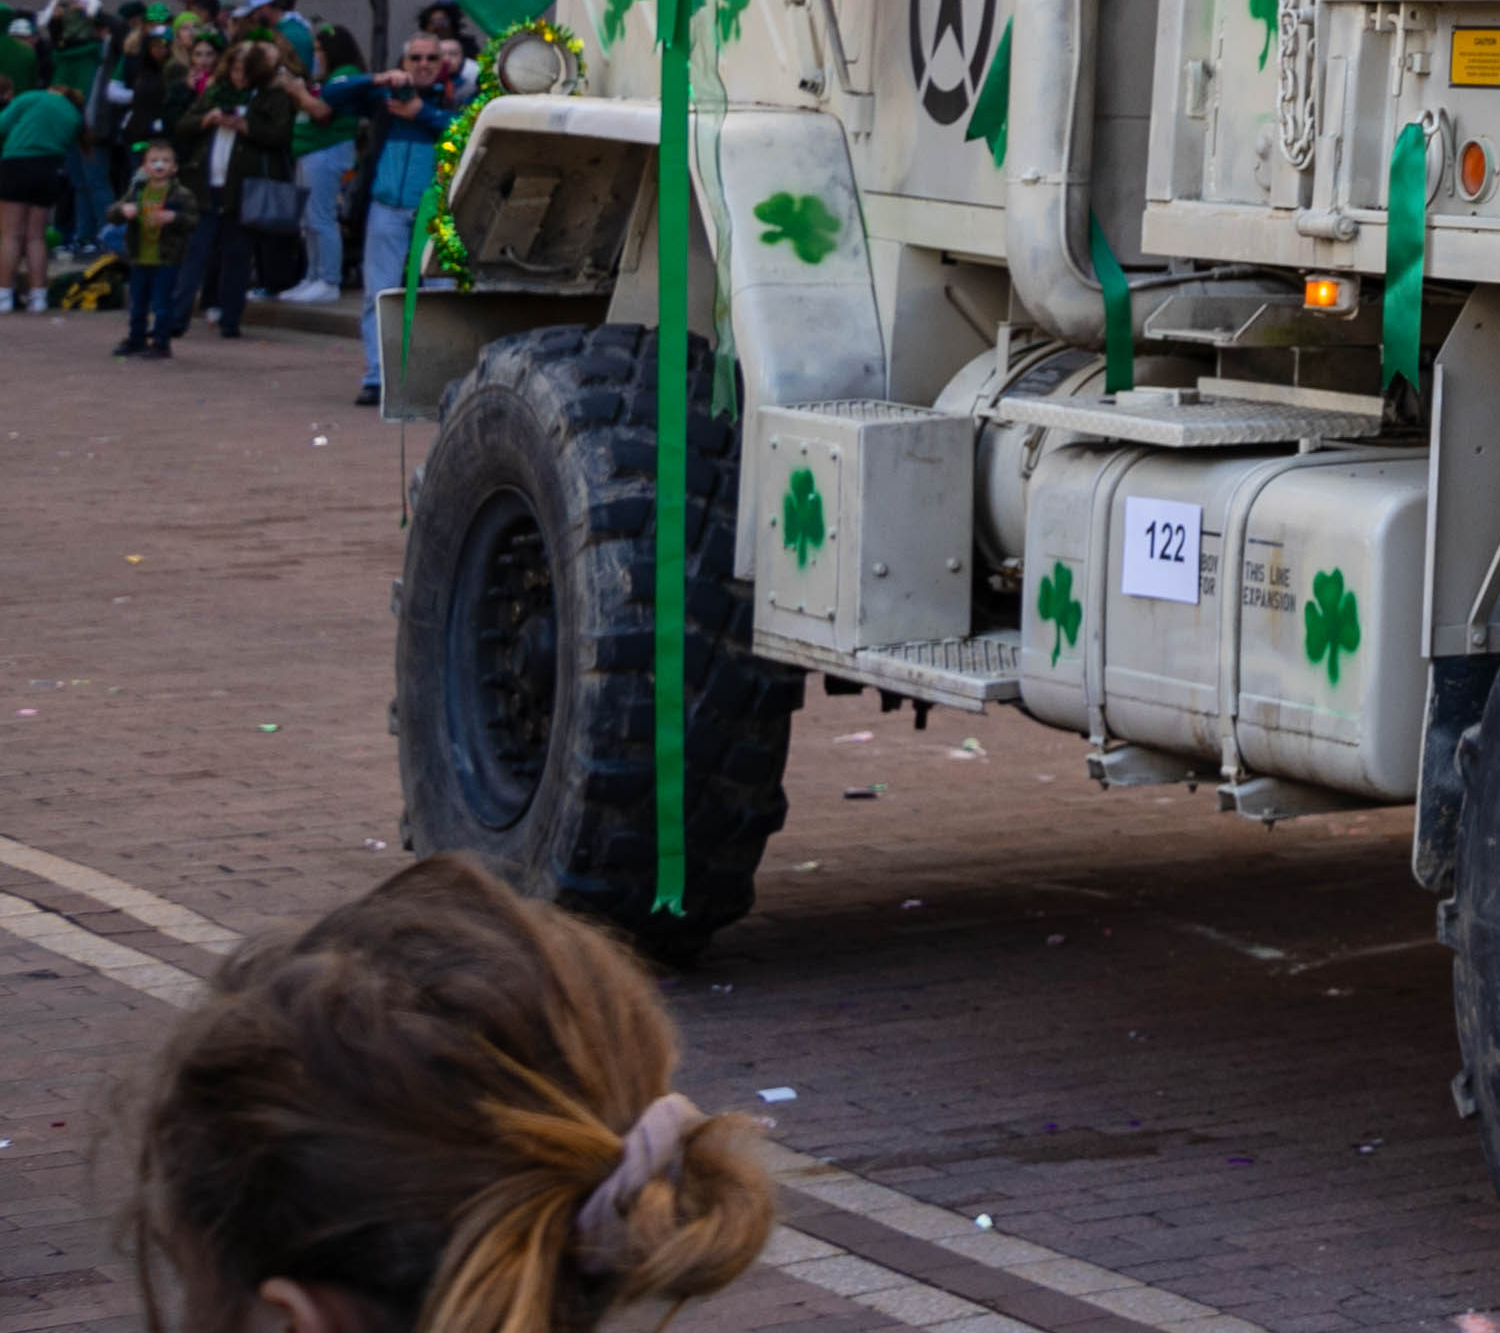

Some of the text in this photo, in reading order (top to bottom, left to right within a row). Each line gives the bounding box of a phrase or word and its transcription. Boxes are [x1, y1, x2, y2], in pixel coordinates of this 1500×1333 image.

[1145, 520, 1187, 563] 122
[1246, 560, 1265, 583] THIS
[1243, 586, 1297, 613] EXPANSION
